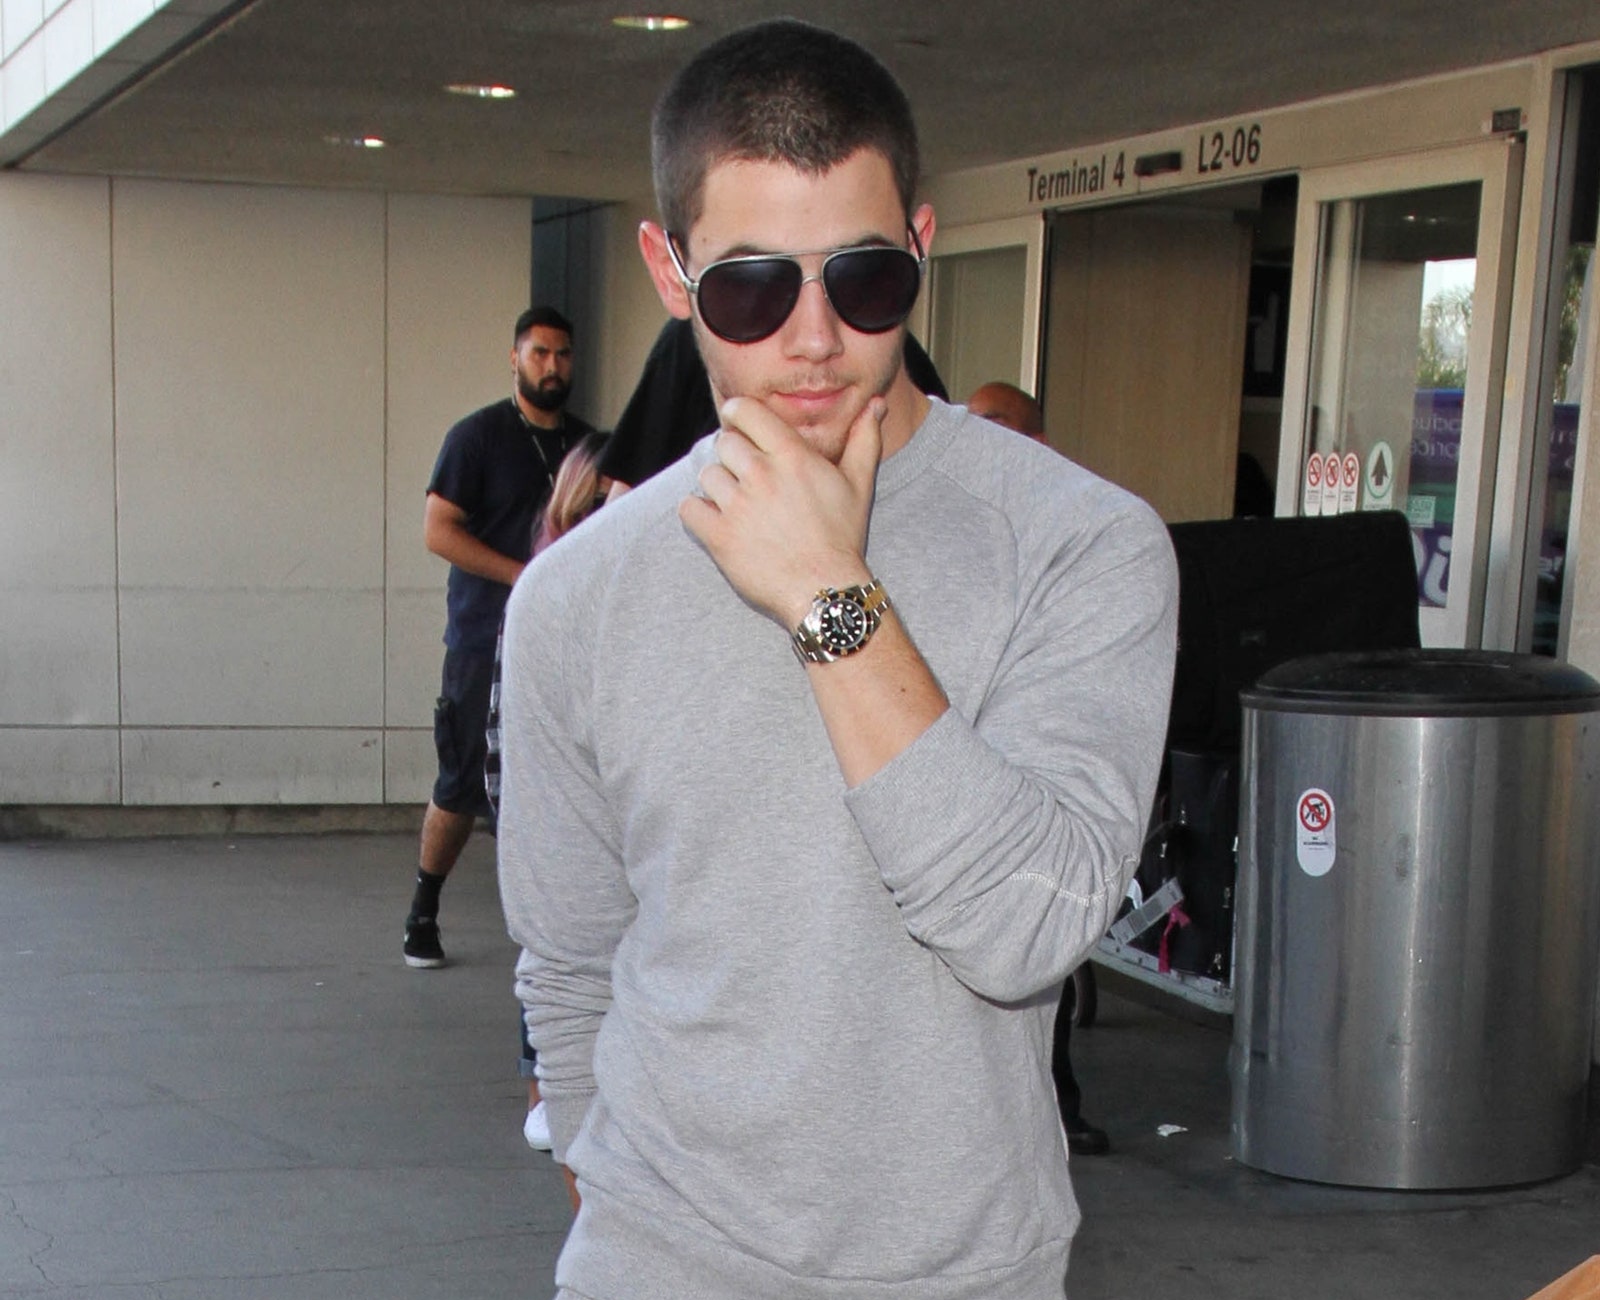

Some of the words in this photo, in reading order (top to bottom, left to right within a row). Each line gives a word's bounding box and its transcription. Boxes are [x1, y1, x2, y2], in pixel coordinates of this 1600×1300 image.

[1028, 154, 1106, 202] Terminal
[1113, 151, 1125, 187] 4
[1198, 123, 1262, 174] L2-06
